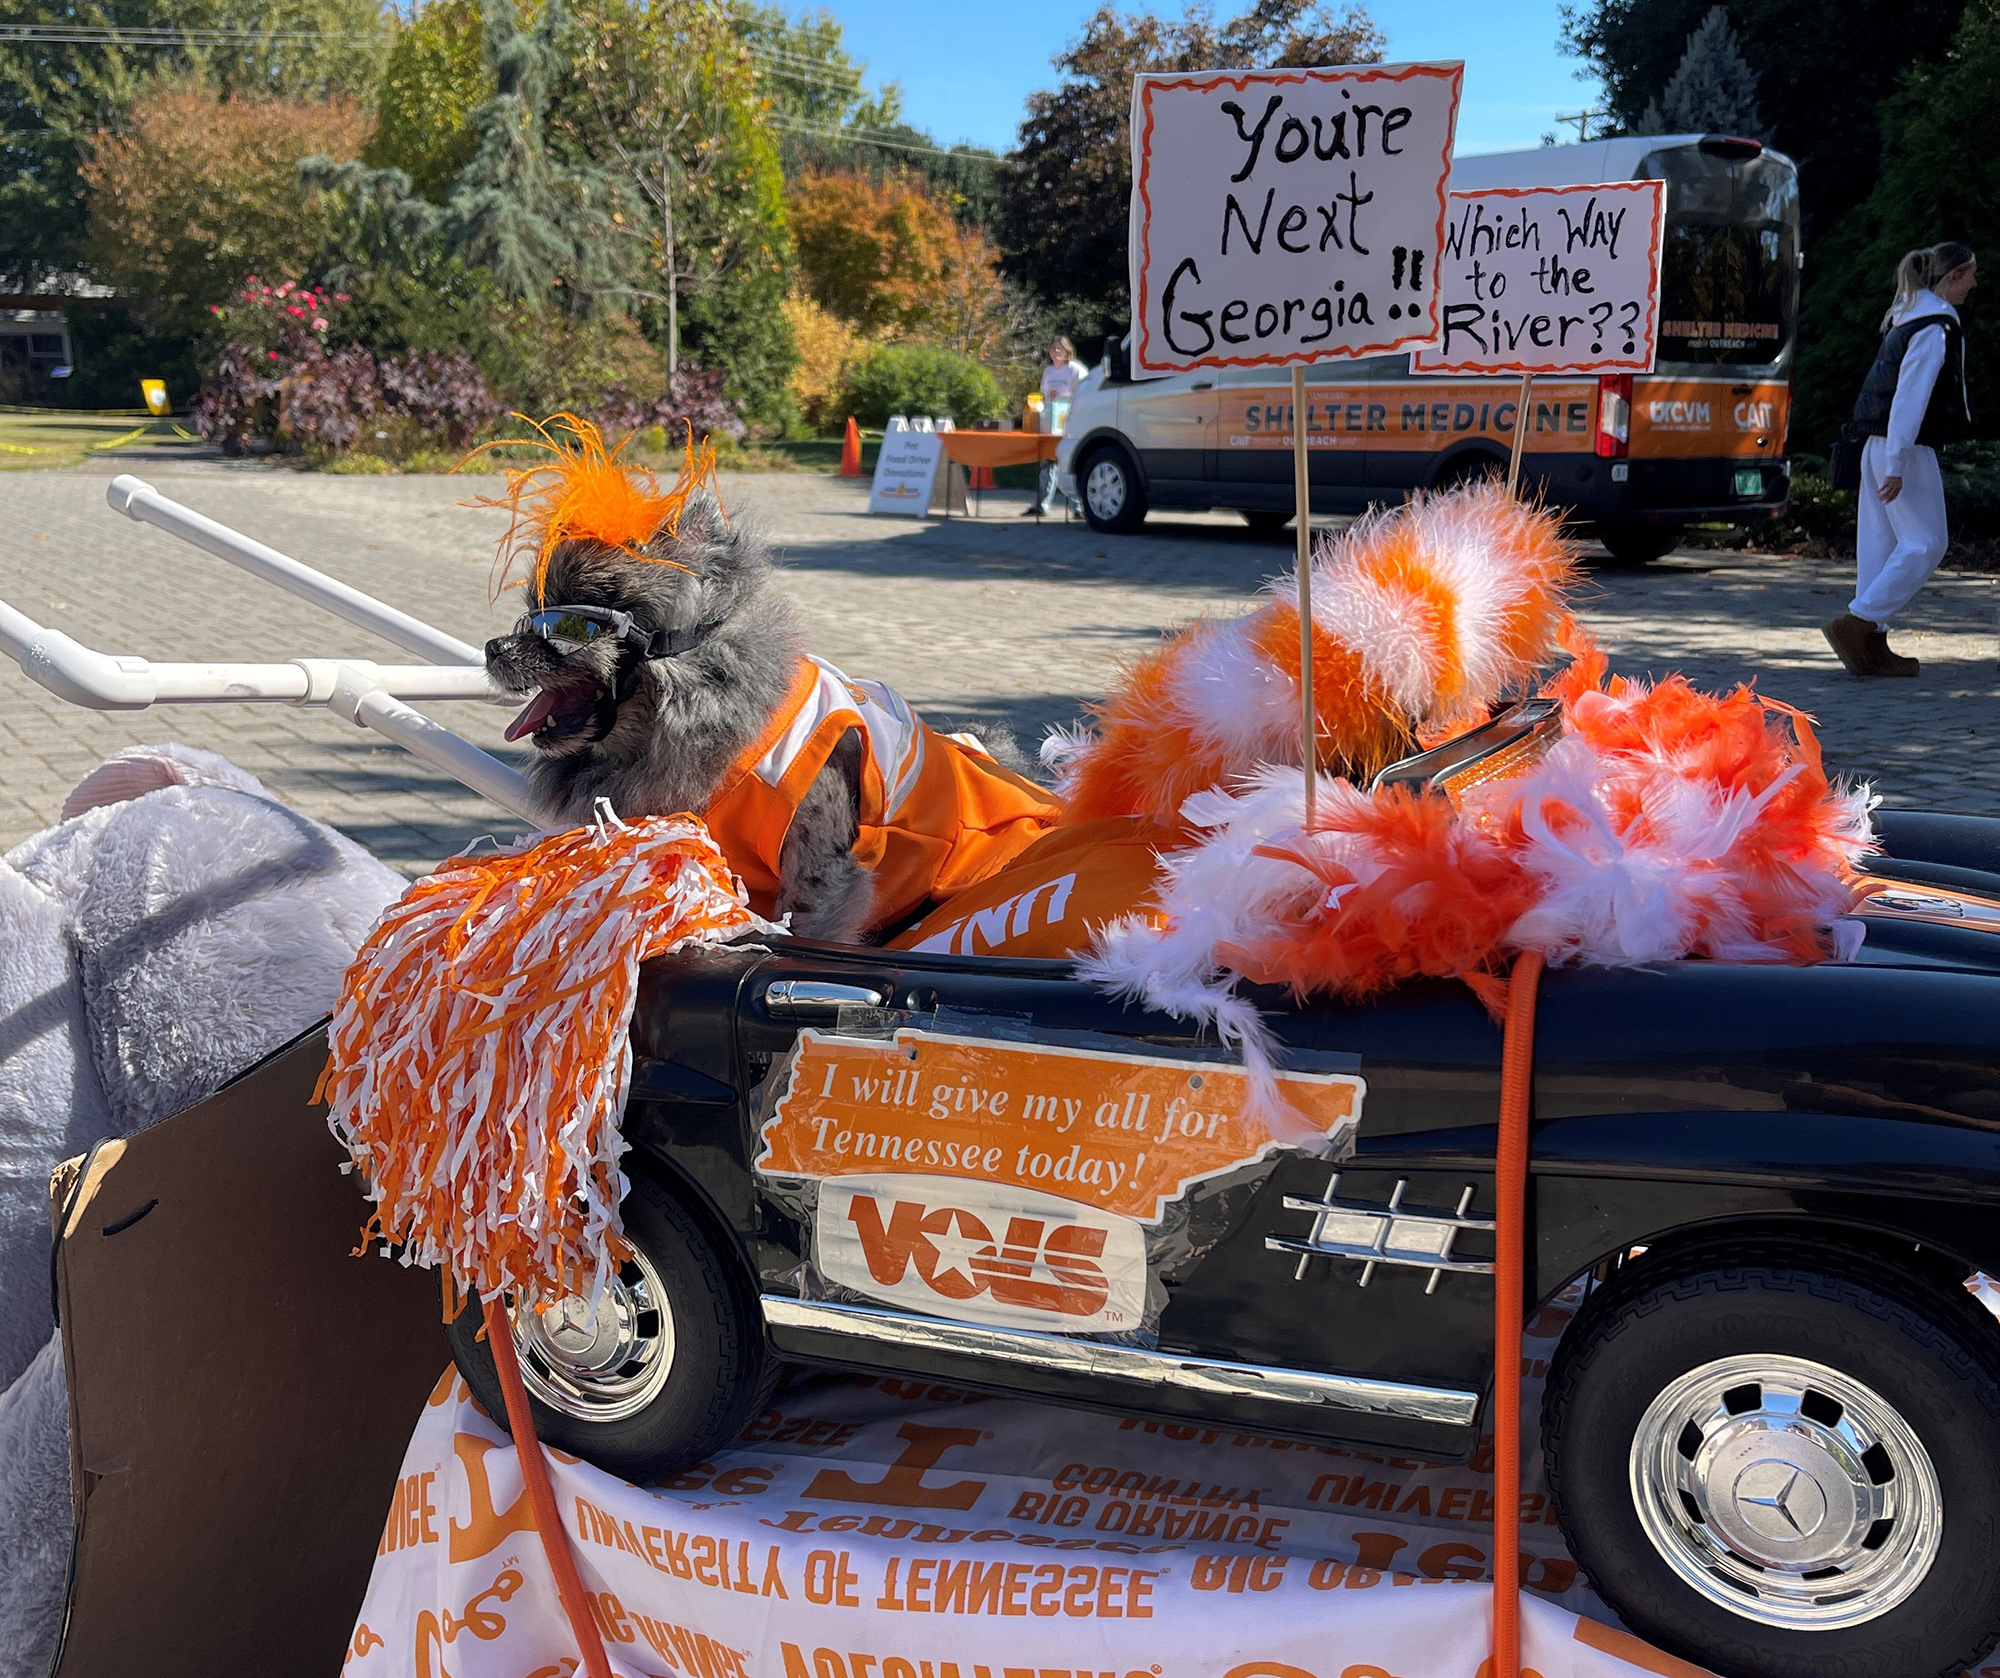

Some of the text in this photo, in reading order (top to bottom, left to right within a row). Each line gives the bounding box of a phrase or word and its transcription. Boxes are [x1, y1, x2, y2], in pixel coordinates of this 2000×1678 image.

[1221, 171, 1374, 256] Next
[1465, 255, 1595, 300] to the
[1401, 402, 1588, 432] MEDICINE
[820, 1063, 1229, 1144] I will give my all for
[809, 1116, 1148, 1197] Tennessee today!
[848, 1195, 1108, 1317] VOLS
